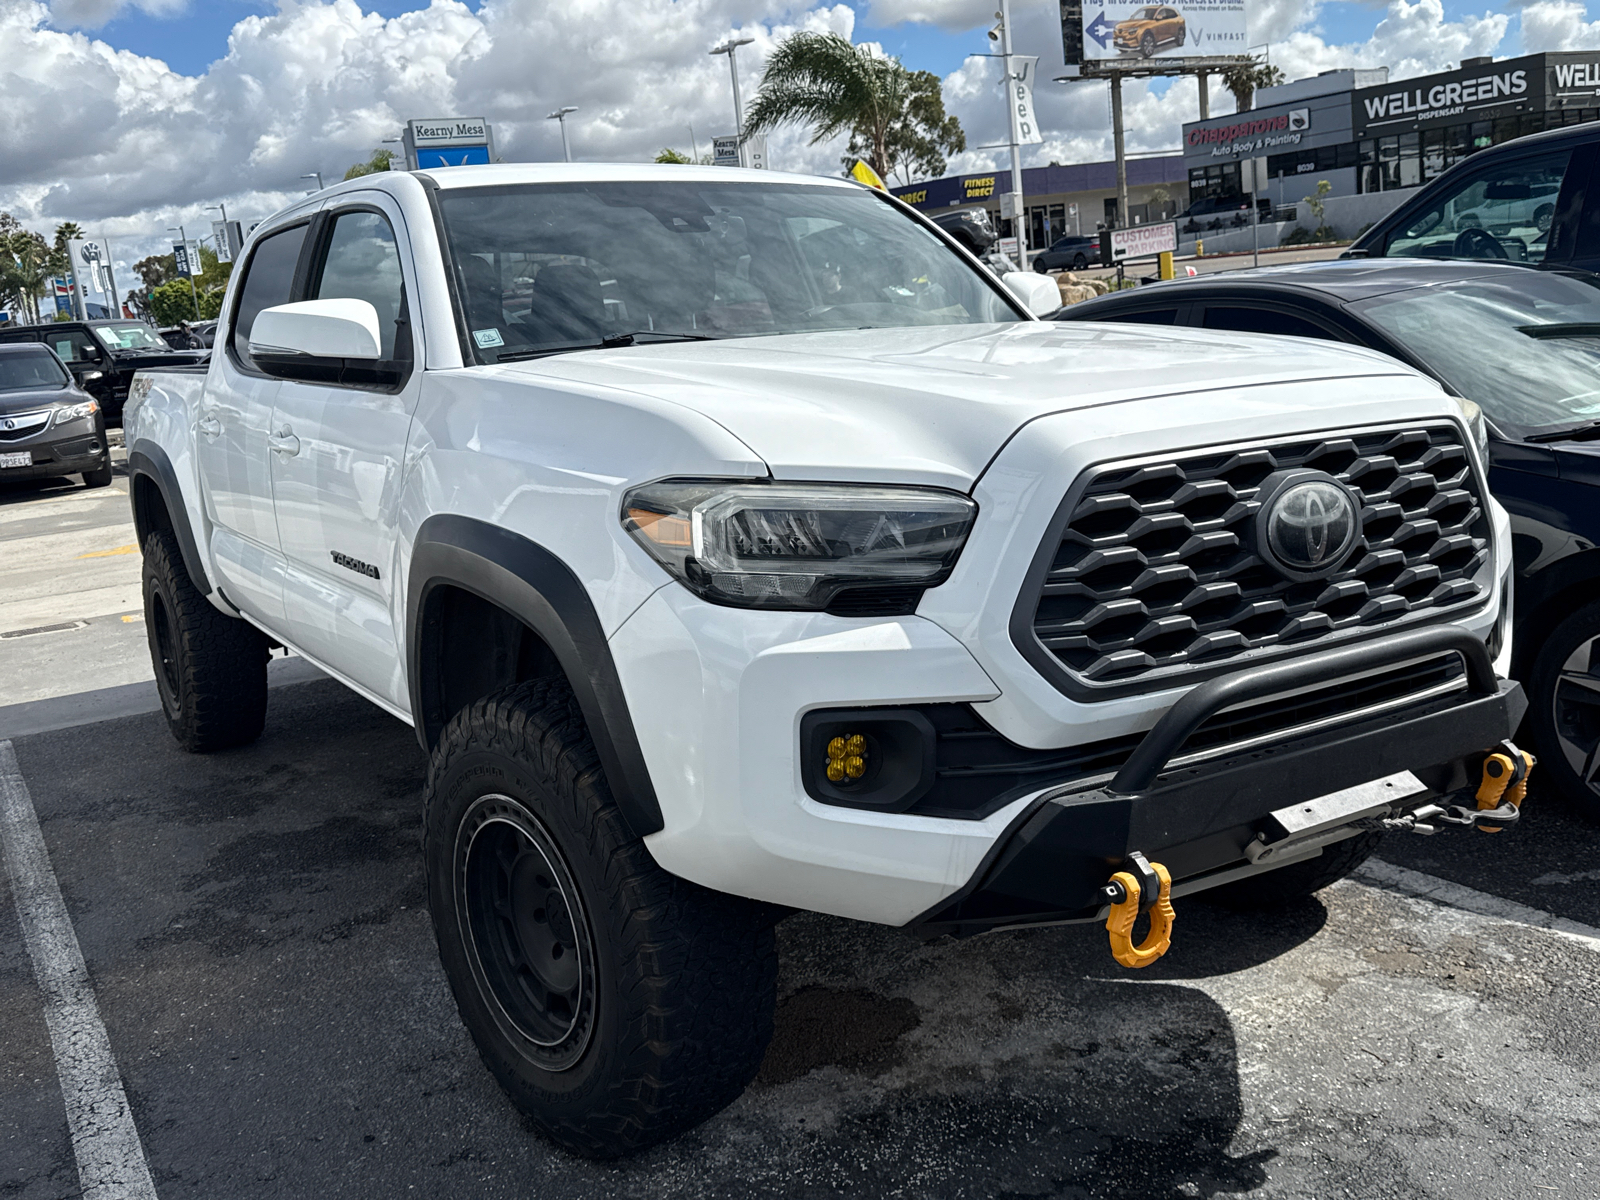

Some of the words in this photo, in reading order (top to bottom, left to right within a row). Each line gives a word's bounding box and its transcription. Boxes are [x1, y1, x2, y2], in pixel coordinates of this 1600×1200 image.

[1206, 33, 1245, 41] VINFAST
[1016, 62, 1032, 140] Jeep
[1364, 70, 1528, 120] WELLGREENS
[1417, 105, 1465, 121] DISPENSARY
[415, 125, 454, 140] Kearny
[456, 124, 484, 136] Mesa
[713, 139, 738, 149] Kearny
[1211, 146, 1231, 157] Auto
[1232, 140, 1254, 154] Body
[1255, 138, 1263, 149] &
[1264, 133, 1301, 148] Painting
[717, 149, 735, 157] Mesa
[964, 177, 996, 188] FITNESS
[966, 187, 995, 198] DIRECT
[1114, 224, 1174, 245] CUSTOMER
[1127, 237, 1176, 256] PARKING
[330, 550, 381, 580] TACOMA
